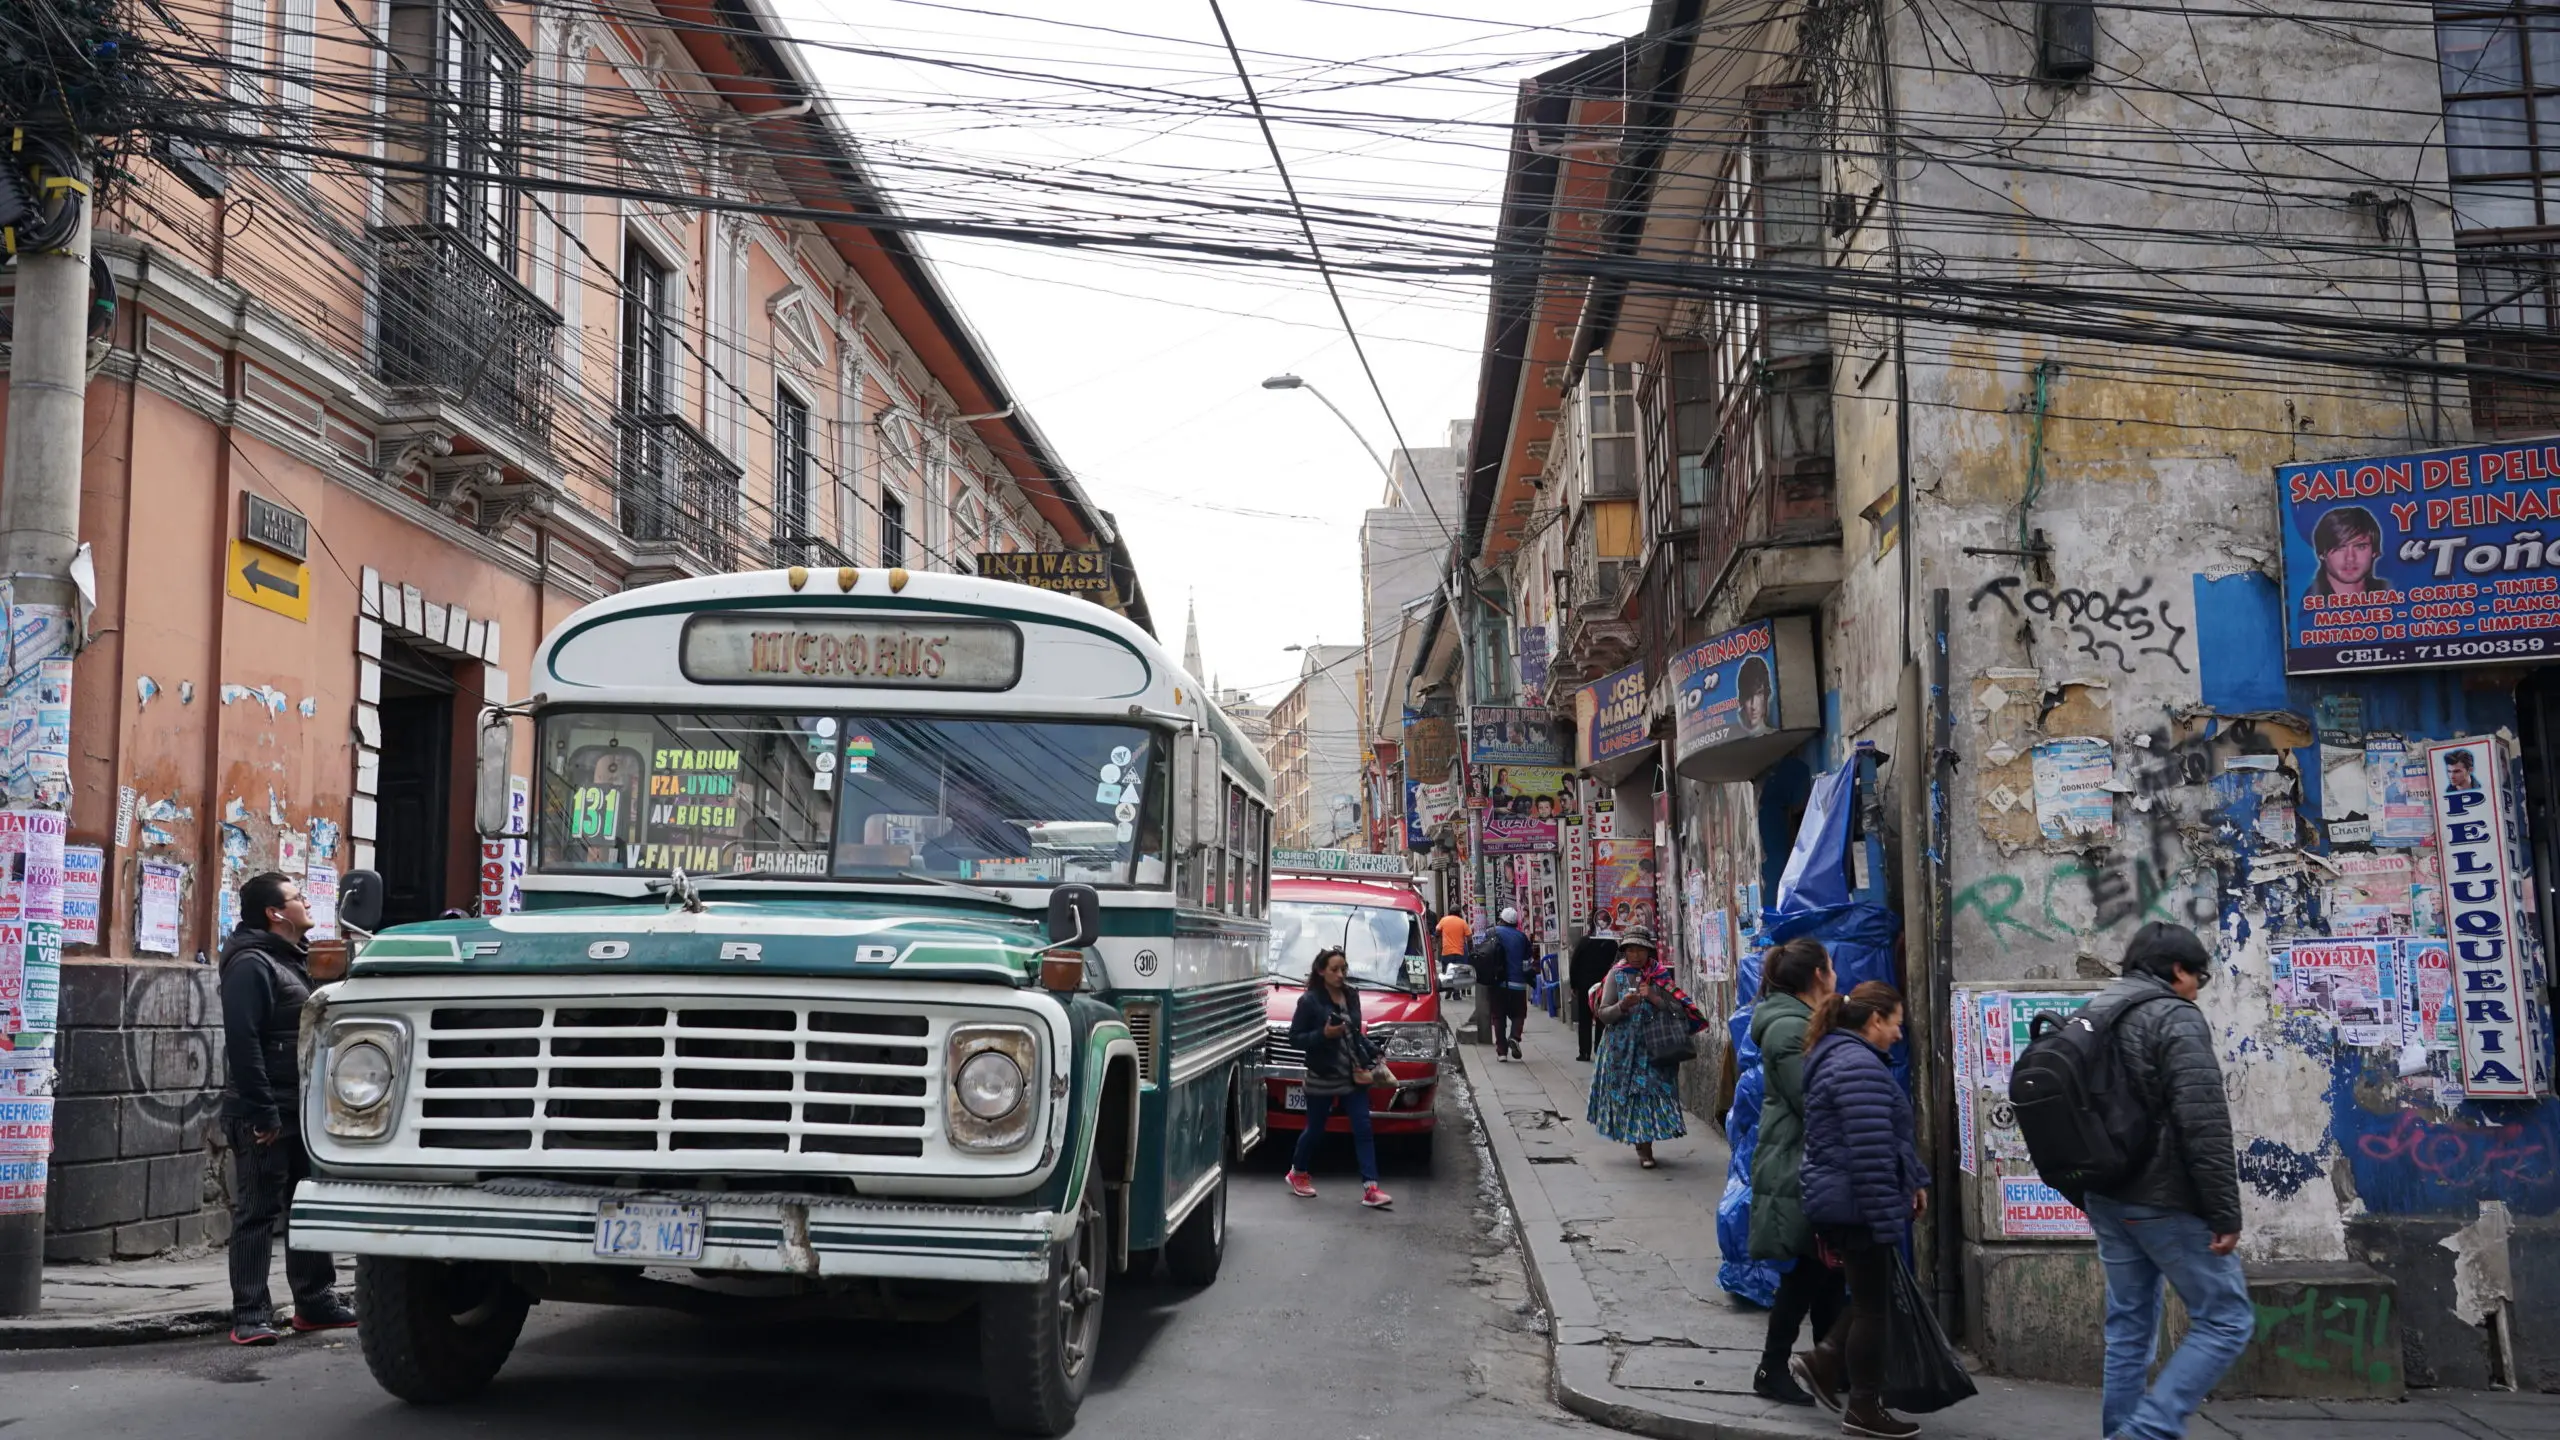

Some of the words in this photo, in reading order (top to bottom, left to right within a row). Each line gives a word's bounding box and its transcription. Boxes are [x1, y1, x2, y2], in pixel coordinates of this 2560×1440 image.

[2290, 463, 2412, 503] SALON
[2422, 456, 2470, 490] DE
[264, 505, 297, 532] CALLE
[2390, 501, 2417, 532] Y
[982, 553, 1106, 575] INTIWASI
[1028, 575, 1108, 591] Packers
[2304, 595, 2324, 610] SE
[2330, 590, 2404, 608] REALIZA:
[2409, 583, 2477, 603] CORTES
[2495, 577, 2557, 595] TINTES
[2314, 608, 2393, 627] MASAJES
[2411, 602, 2475, 620] ONDAS
[2301, 627, 2377, 645] PINTADO
[2383, 624, 2405, 639] DE
[2410, 619, 2460, 637] UÑAS
[2478, 613, 2560, 633] LIMPIEZA
[1696, 626, 1770, 670] PEINADOS
[2414, 638, 2545, 661] 71500359
[1608, 671, 1645, 703] JOSE
[1600, 693, 1647, 728] MARIA
[1600, 728, 1647, 754] UNISEX
[655, 749, 740, 772] STADIUM
[572, 787, 620, 841] 131
[1571, 828, 1582, 861] JUAN
[1277, 851, 1316, 860] OBRERO
[1318, 851, 1345, 869] 897
[1350, 854, 1401, 865] CEMENTERIO
[1350, 862, 1399, 873] KOLLASUYO
[1571, 866, 1582, 882] DE
[1572, 885, 1583, 918] DIOS
[2443, 791, 2523, 1084] PELUQUERIA
[462, 940, 898, 964] FORD
[1140, 955, 1154, 971] 310
[2293, 950, 2375, 967] JOYERIA
[1407, 960, 1426, 975] 13
[625, 1206, 678, 1218] BOLIVIA
[656, 1221, 699, 1252] NAT
